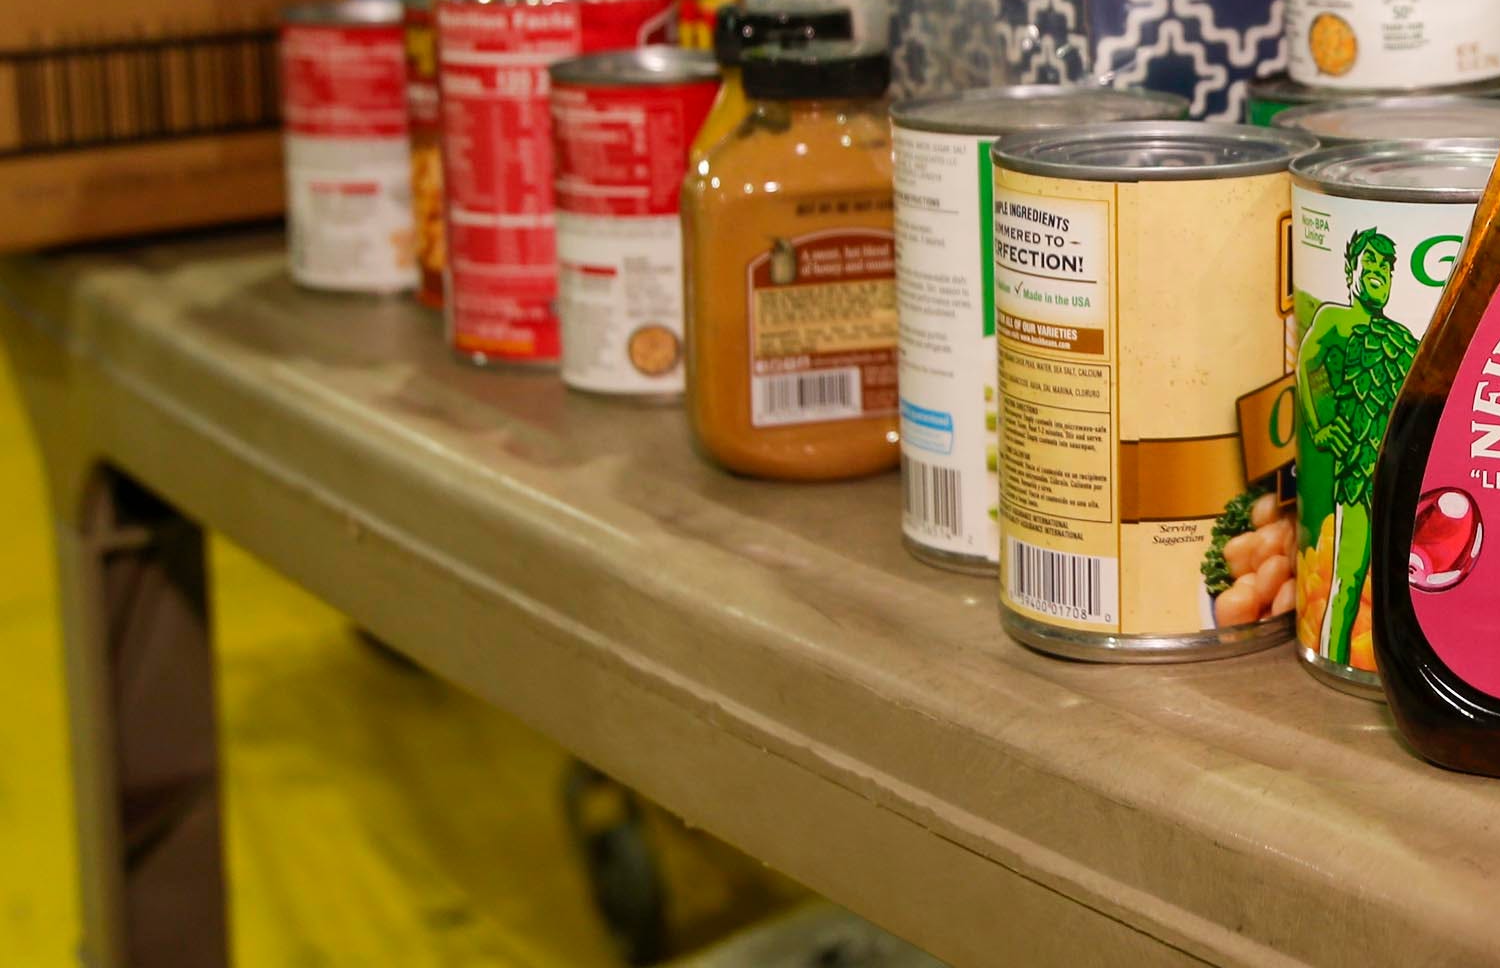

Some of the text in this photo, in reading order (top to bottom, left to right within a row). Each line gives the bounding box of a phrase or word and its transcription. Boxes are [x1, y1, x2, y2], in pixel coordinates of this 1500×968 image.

[1009, 202, 1070, 233] INGREDIENTS
[1301, 213, 1330, 233] Non-BPA
[1045, 234, 1065, 248] TO
[995, 238, 1084, 273] RFECTION!
[1023, 288, 1091, 308] Made in the USA
[1022, 321, 1036, 334] OUR
[1037, 324, 1077, 341] VARIETIES
[1077, 367, 1103, 378] CALCIUM
[1033, 513, 1069, 529] INTERNATIONAL
[1044, 525, 1084, 541] INTERNATIONAL
[1152, 533, 1205, 545] Suggestion
[1159, 524, 1198, 538] Serving
[1051, 601, 1088, 620] 01708
[1104, 613, 1111, 623] 0
